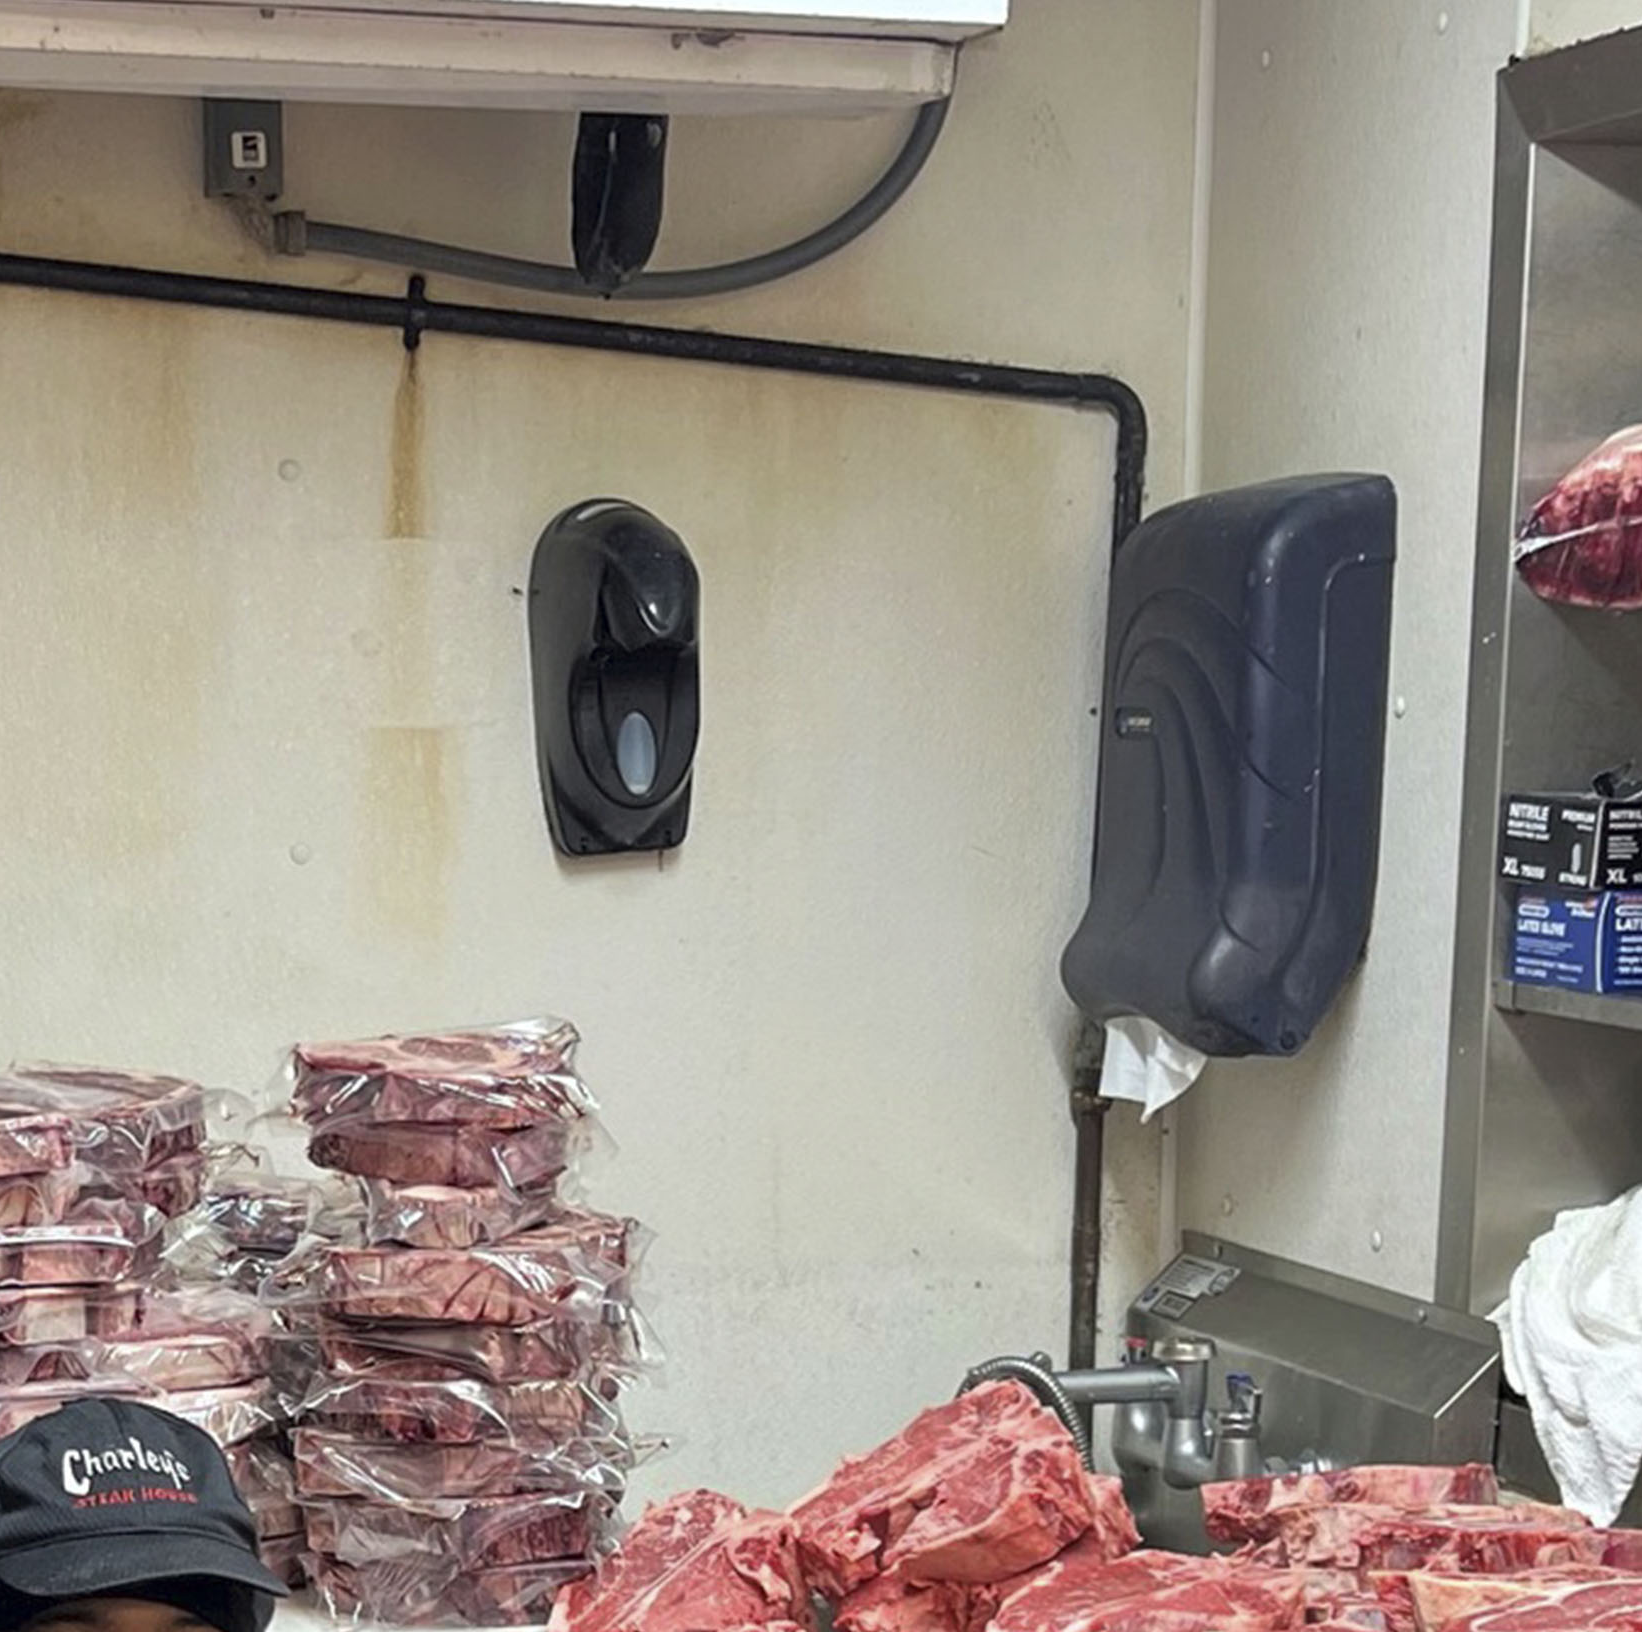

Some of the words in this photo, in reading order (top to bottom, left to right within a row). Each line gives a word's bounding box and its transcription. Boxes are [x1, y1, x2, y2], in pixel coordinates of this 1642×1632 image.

[1606, 868, 1628, 884] XL
[62, 1437, 191, 1496] Charley's
[73, 1488, 135, 1509] STEAK
[141, 1487, 198, 1504] HOUSE
